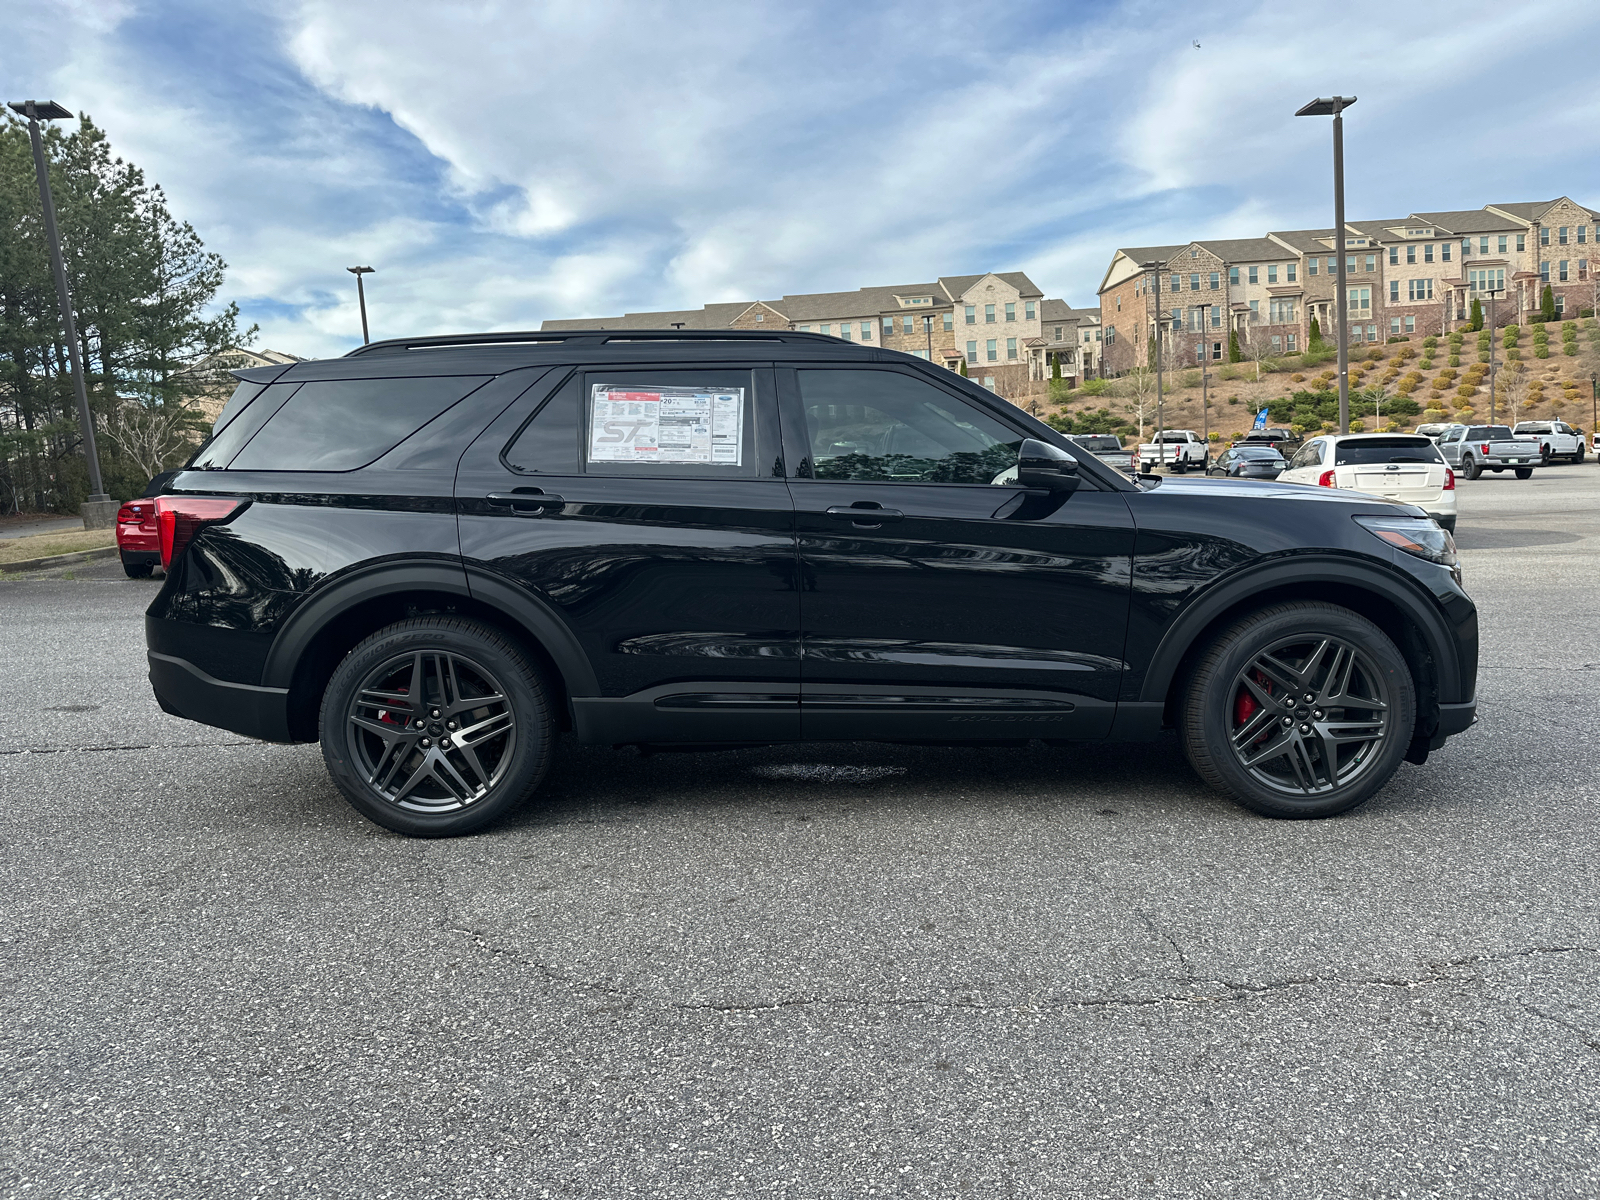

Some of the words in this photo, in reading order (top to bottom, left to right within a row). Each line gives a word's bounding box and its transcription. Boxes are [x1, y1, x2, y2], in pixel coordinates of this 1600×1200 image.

[597, 421, 653, 443] ST
[336, 639, 394, 696] SCORPION
[400, 633, 446, 643] ZERO
